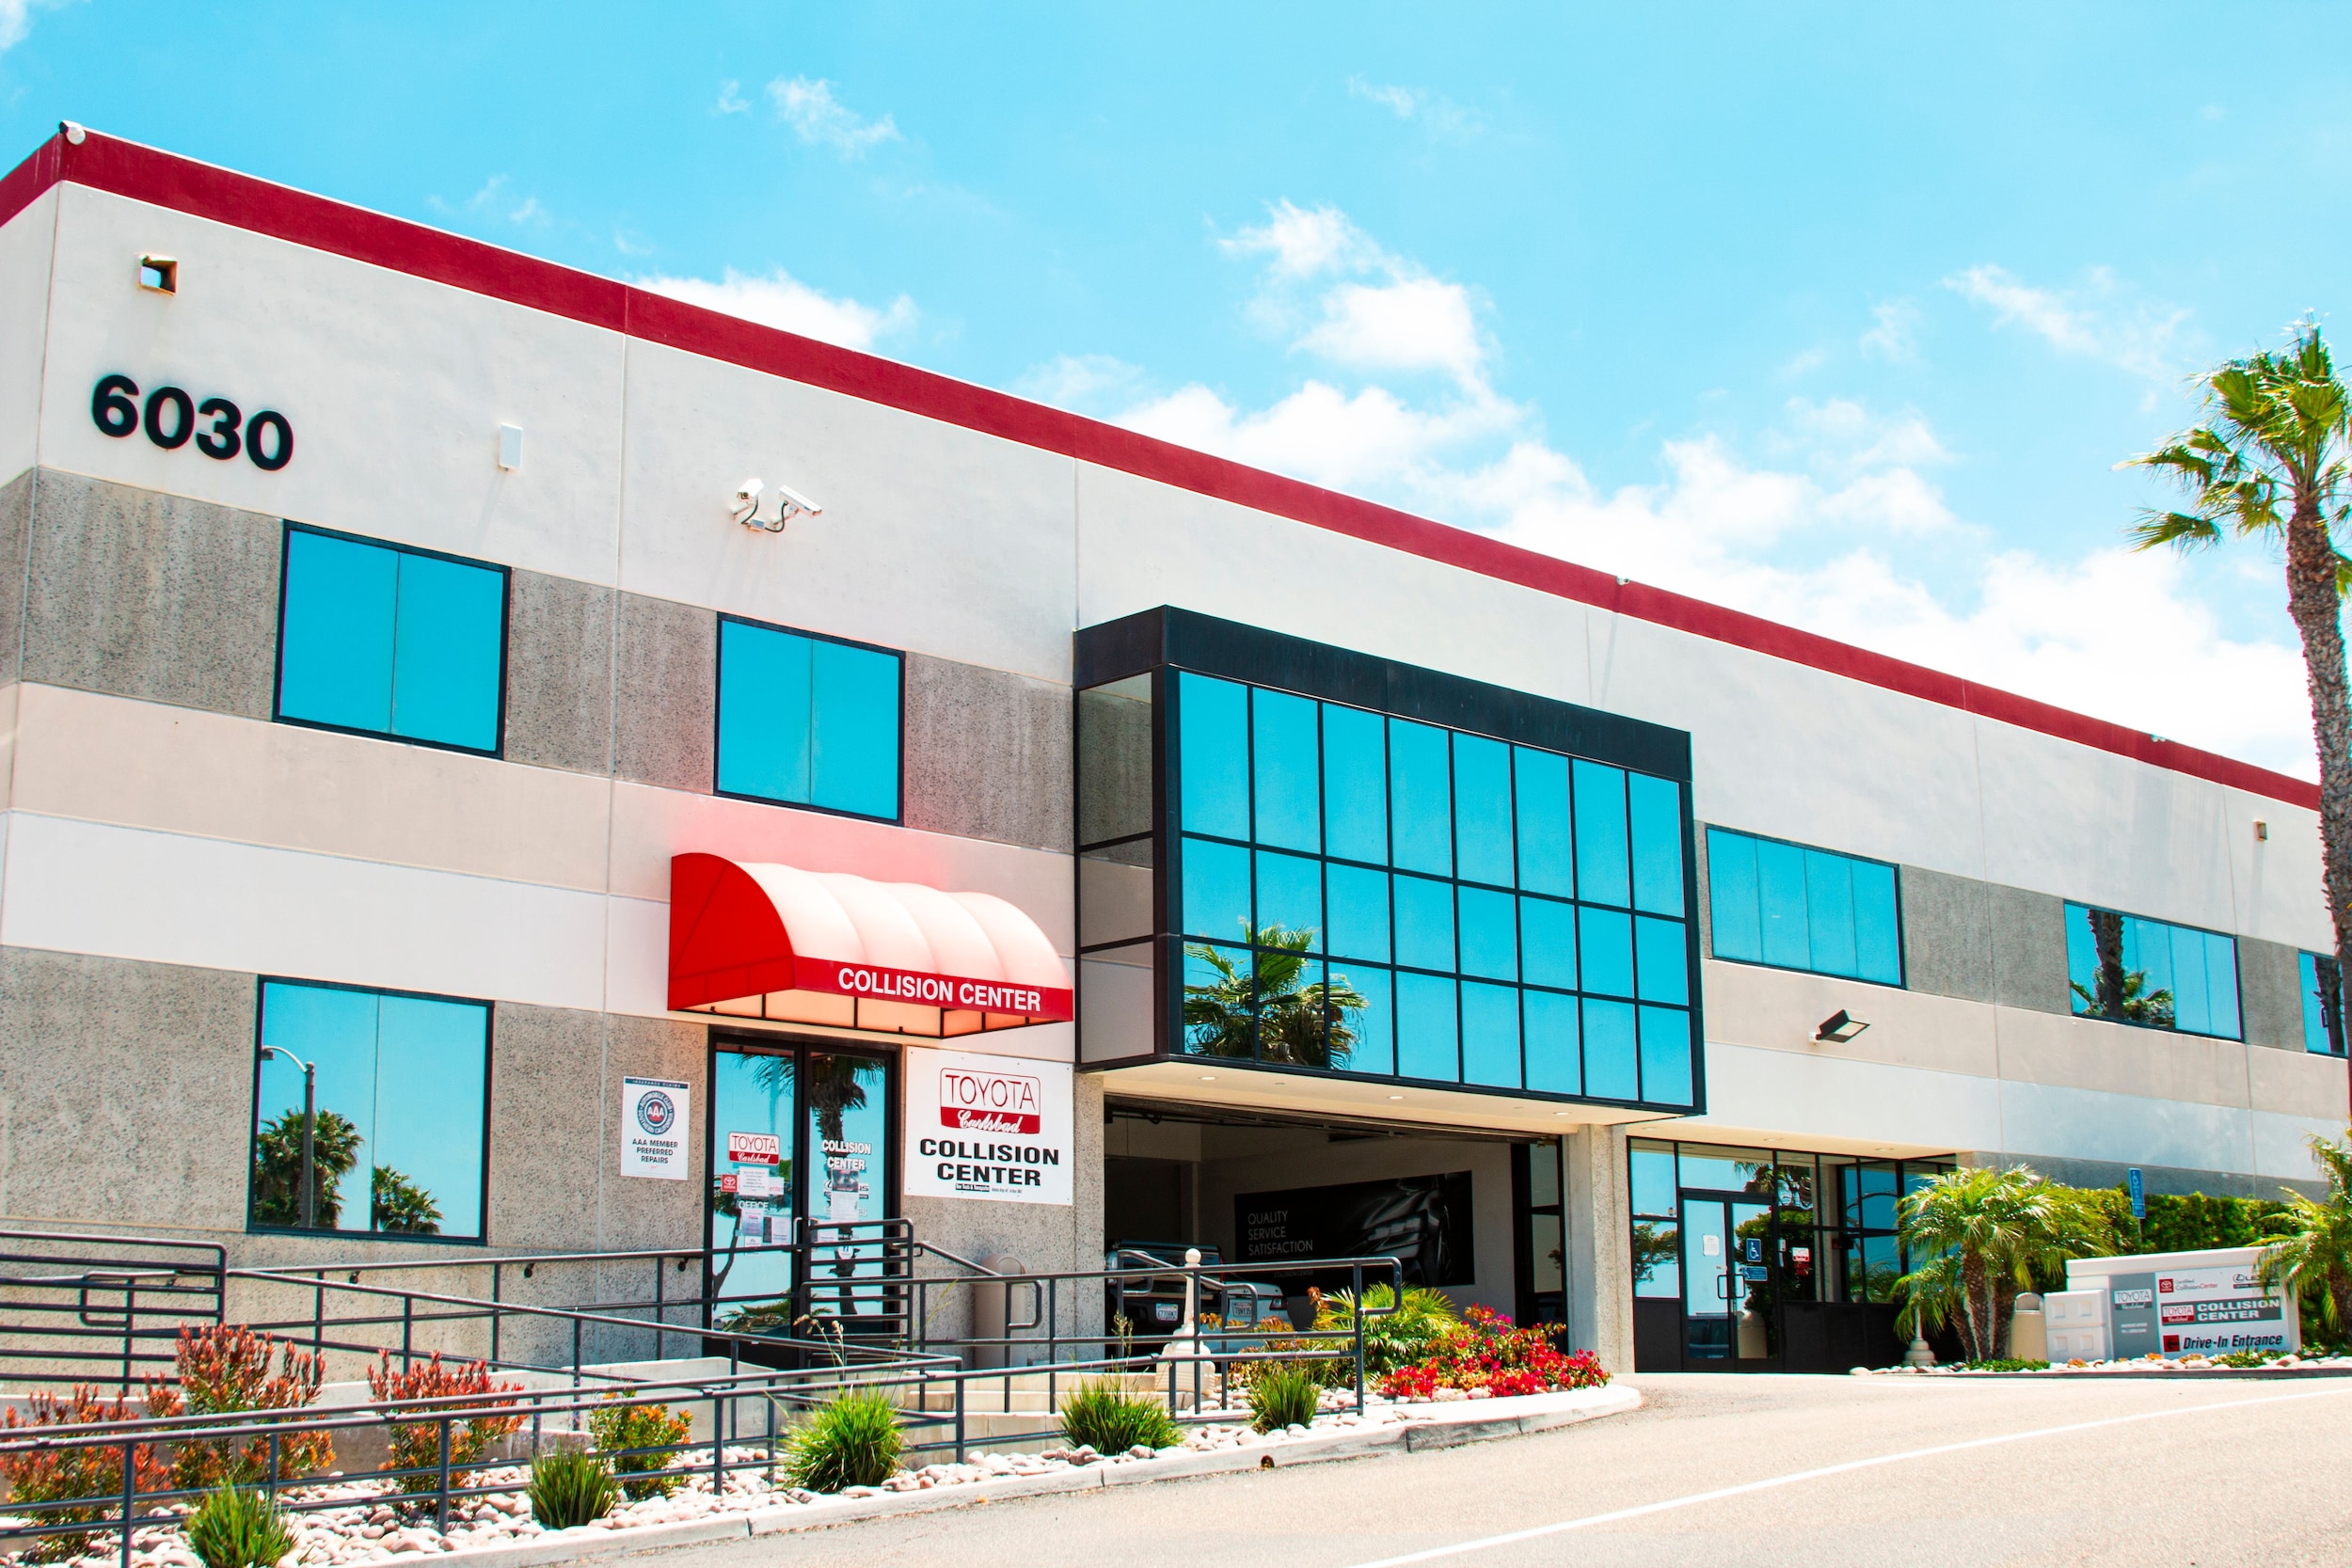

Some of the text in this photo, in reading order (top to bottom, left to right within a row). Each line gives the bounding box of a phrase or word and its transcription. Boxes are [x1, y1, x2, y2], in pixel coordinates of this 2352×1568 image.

[91, 374, 294, 471] 6030
[838, 968, 1041, 1012] COLLISION CENTER
[946, 1074, 1036, 1111] TOYOTA
[647, 1105, 664, 1117] AAA
[957, 1109, 1024, 1133] Carlsbad
[649, 1139, 678, 1148] MEMBER
[732, 1135, 777, 1152] TOYOTA
[821, 1139, 871, 1154] COLLISION
[636, 1147, 674, 1156] PREFERRED
[737, 1152, 771, 1164] Carlsbad
[919, 1138, 1059, 1165] COLLISION
[641, 1155, 669, 1164] REPAIRS
[827, 1157, 866, 1170] CENTER
[937, 1163, 1041, 1187] CENTER
[739, 1200, 769, 1211] OFFICE
[1248, 1210, 1289, 1225] QUALITY
[1248, 1226, 1287, 1241] SERVICE
[1248, 1239, 1313, 1257] SATISFACTION
[2116, 1291, 2151, 1302] TOYOTA
[2164, 1306, 2193, 1316] TOYOTA
[2197, 1298, 2280, 1312] COLLISION
[2198, 1309, 2260, 1321] CENTER
[2183, 1334, 2282, 1350] Drive-In Entrance
